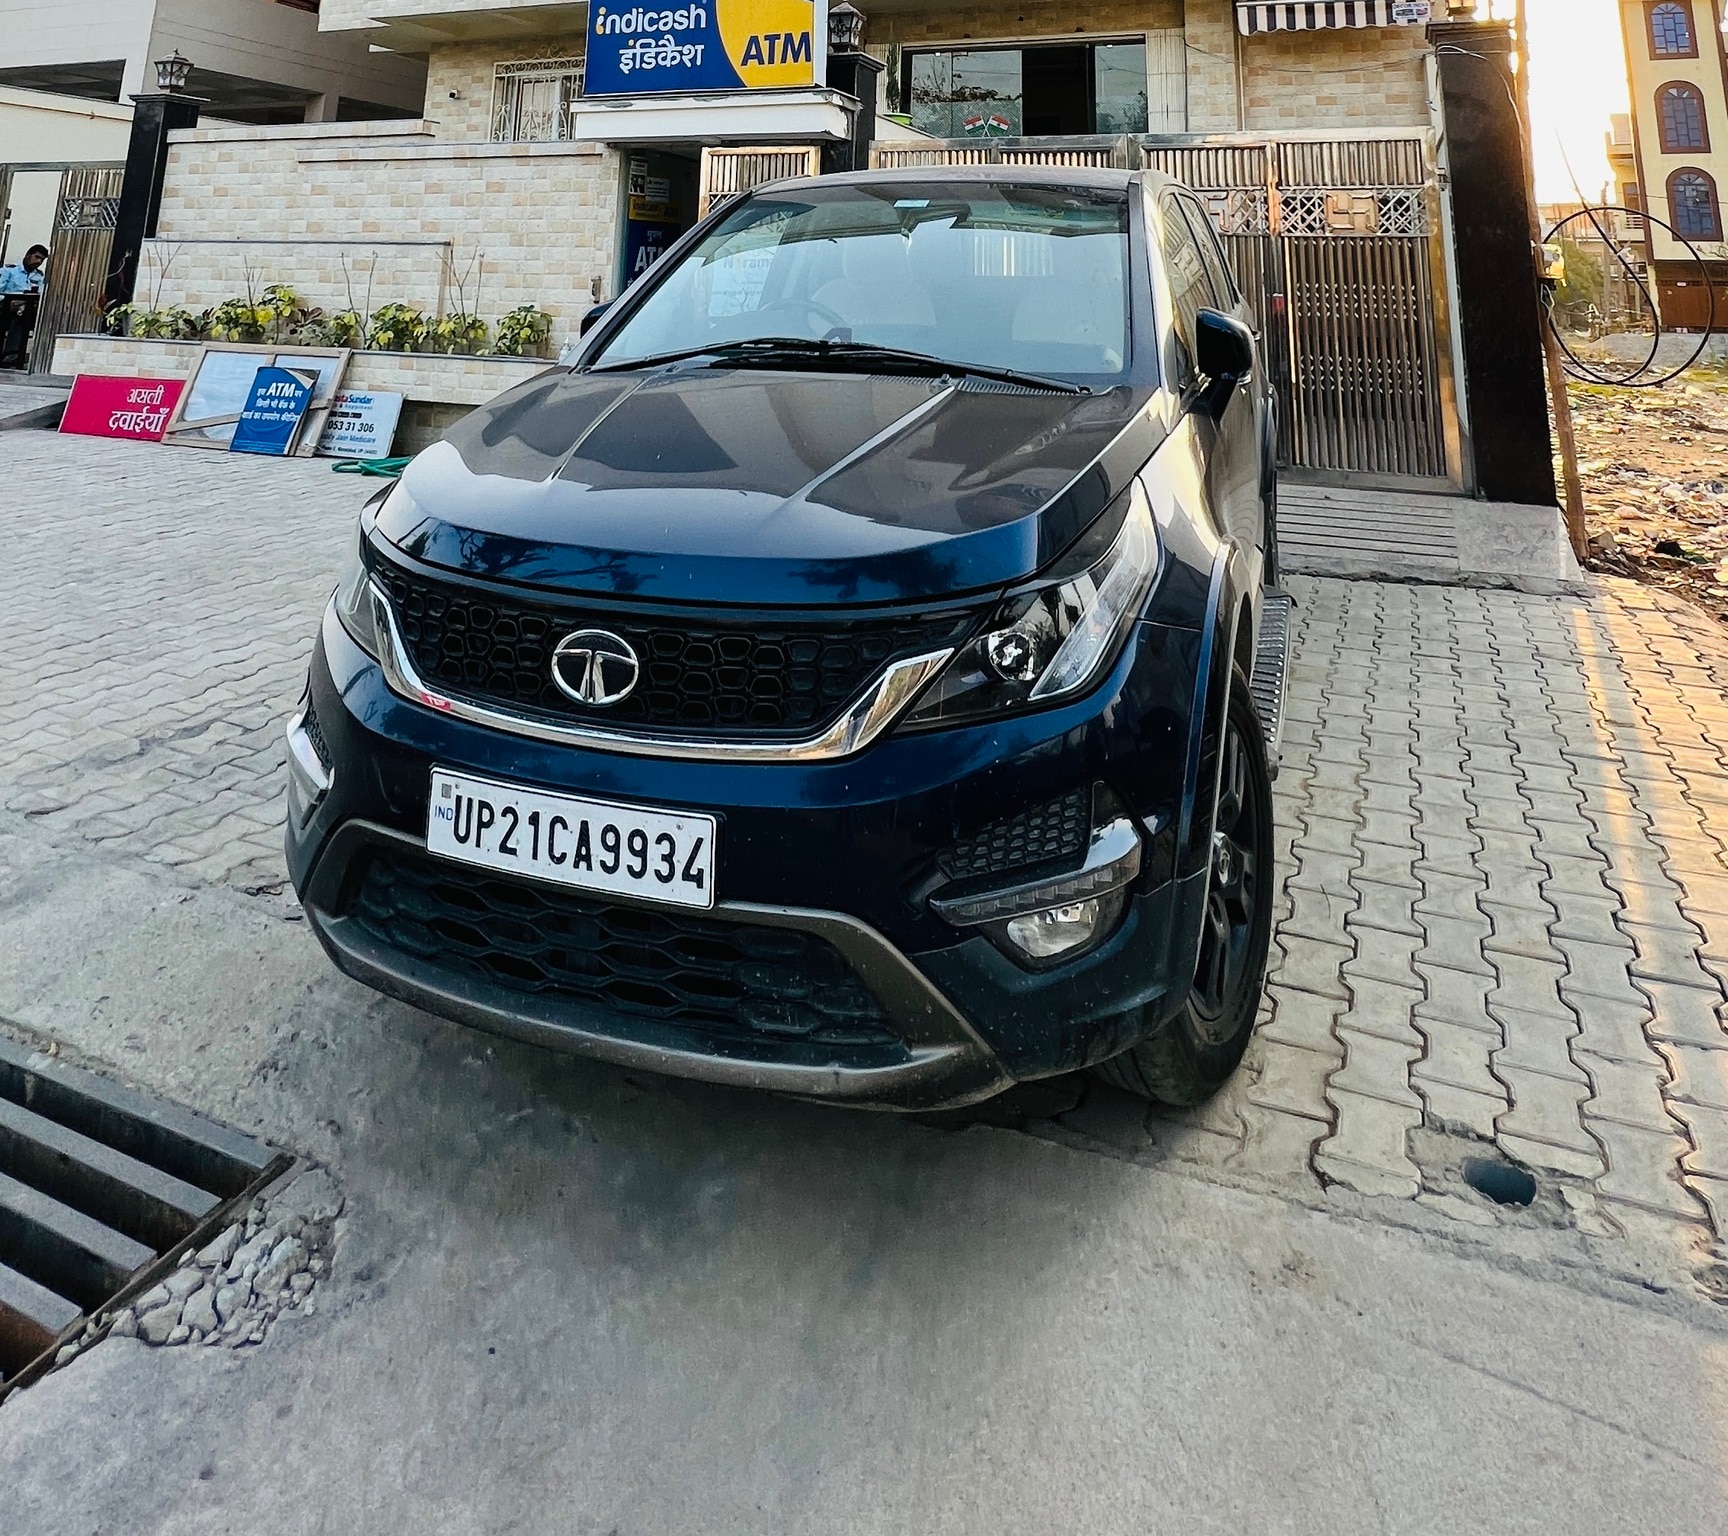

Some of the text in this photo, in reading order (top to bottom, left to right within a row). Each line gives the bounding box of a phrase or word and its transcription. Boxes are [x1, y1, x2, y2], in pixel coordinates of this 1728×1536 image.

[595, 3, 707, 35] indicash
[619, 34, 704, 74] इंडिकैश
[741, 31, 812, 67] ATM
[126, 385, 165, 404] असली
[266, 382, 296, 397] ATM
[334, 394, 374, 404] astaSundar
[109, 406, 170, 433] दवाईयाँ
[327, 420, 375, 433] 053 31 306
[434, 794, 705, 890] IND UP21CA9934
